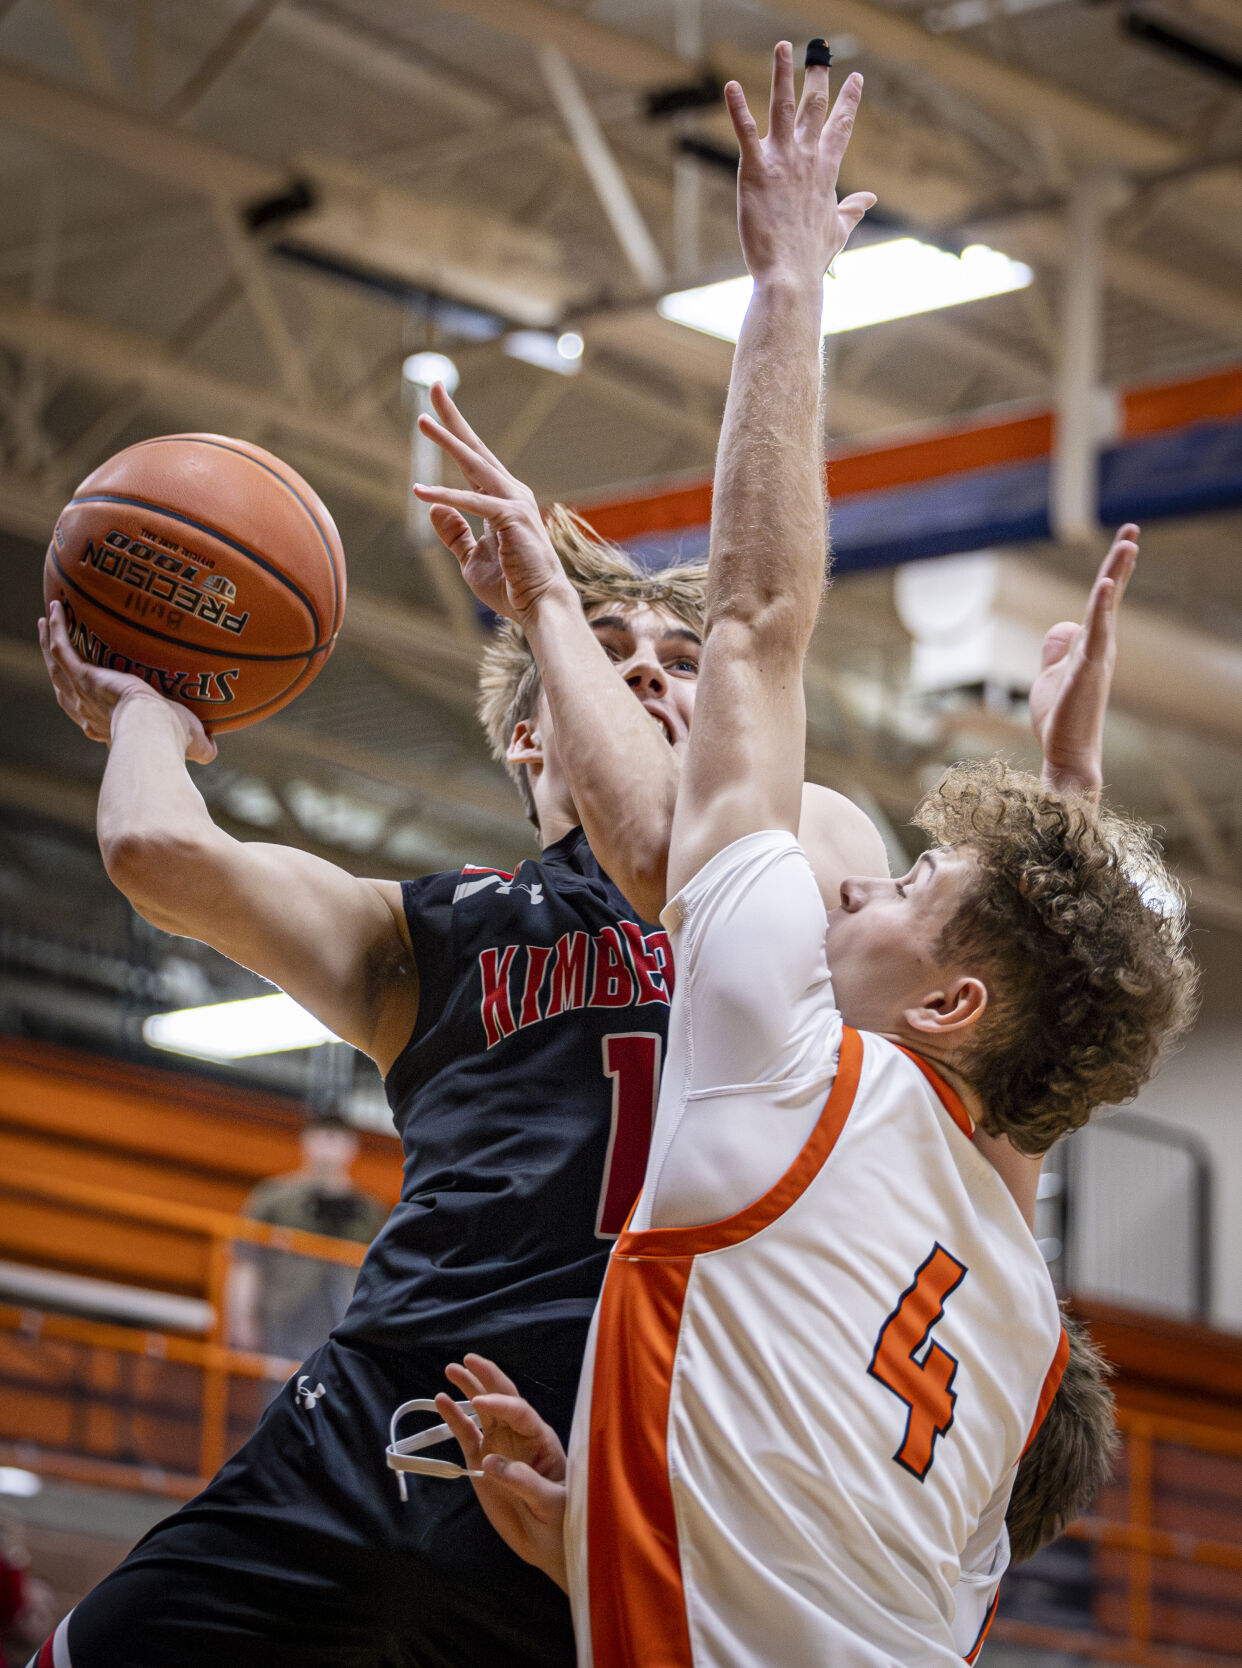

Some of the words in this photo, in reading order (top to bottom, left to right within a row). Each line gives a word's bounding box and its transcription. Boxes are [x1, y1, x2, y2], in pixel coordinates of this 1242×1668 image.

[81, 540, 250, 636] PRECISION
[103, 530, 200, 584] 1000
[594, 1032, 662, 1240] 1
[866, 1240, 968, 1484] 4
